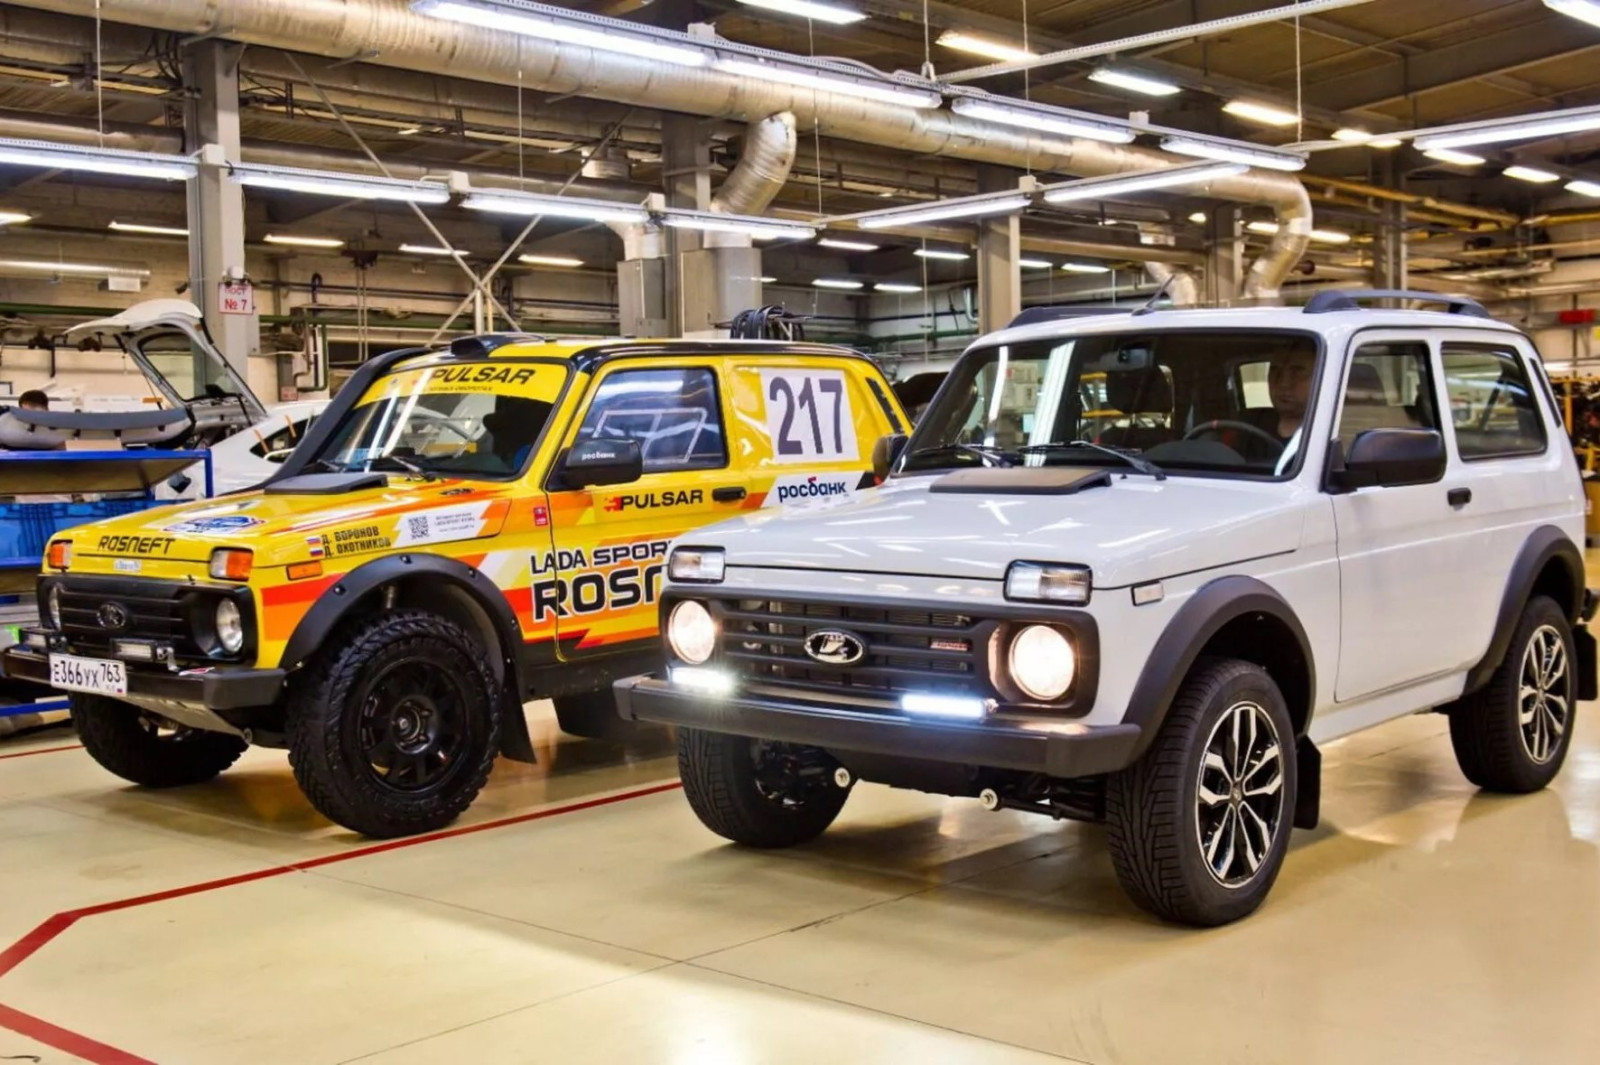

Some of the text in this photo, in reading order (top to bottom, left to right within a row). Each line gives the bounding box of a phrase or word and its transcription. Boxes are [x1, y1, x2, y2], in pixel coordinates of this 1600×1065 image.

[431, 366, 535, 384] PULSAR
[769, 376, 843, 455] 217
[777, 476, 847, 503] росбанк
[620, 489, 703, 511] PULSAR
[334, 526, 380, 541] ВОРОНОВ
[97, 536, 176, 554] ROSNEFT
[336, 537, 391, 554] ОХОТНИКОВ
[531, 540, 672, 574] LADA SPOR
